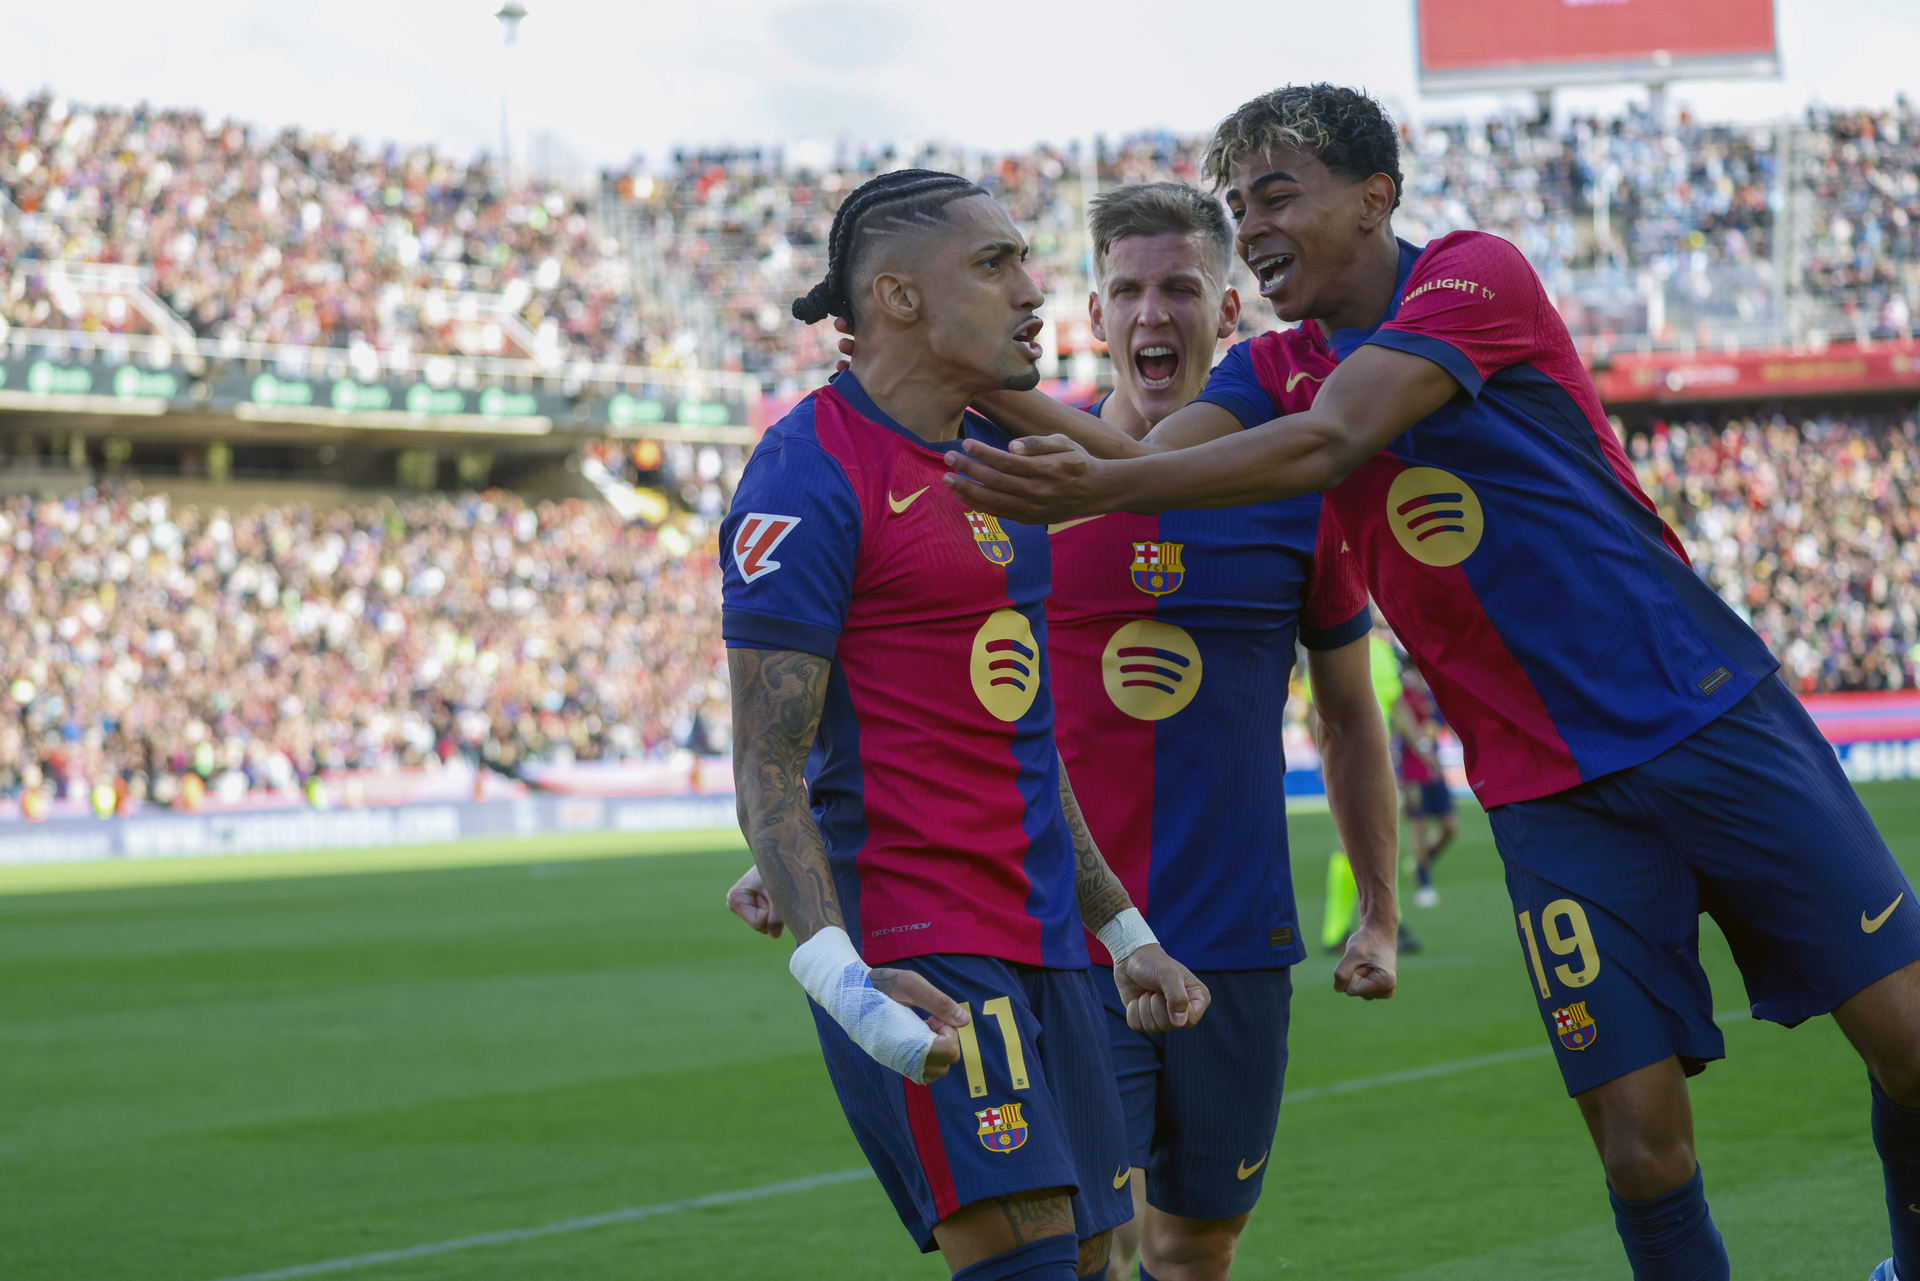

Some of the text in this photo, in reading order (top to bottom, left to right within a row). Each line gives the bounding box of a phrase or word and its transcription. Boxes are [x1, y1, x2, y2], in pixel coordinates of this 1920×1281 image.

[1482, 286, 1496, 300] tv
[1518, 898, 1601, 1000] 19
[957, 996, 1031, 1099] 11
